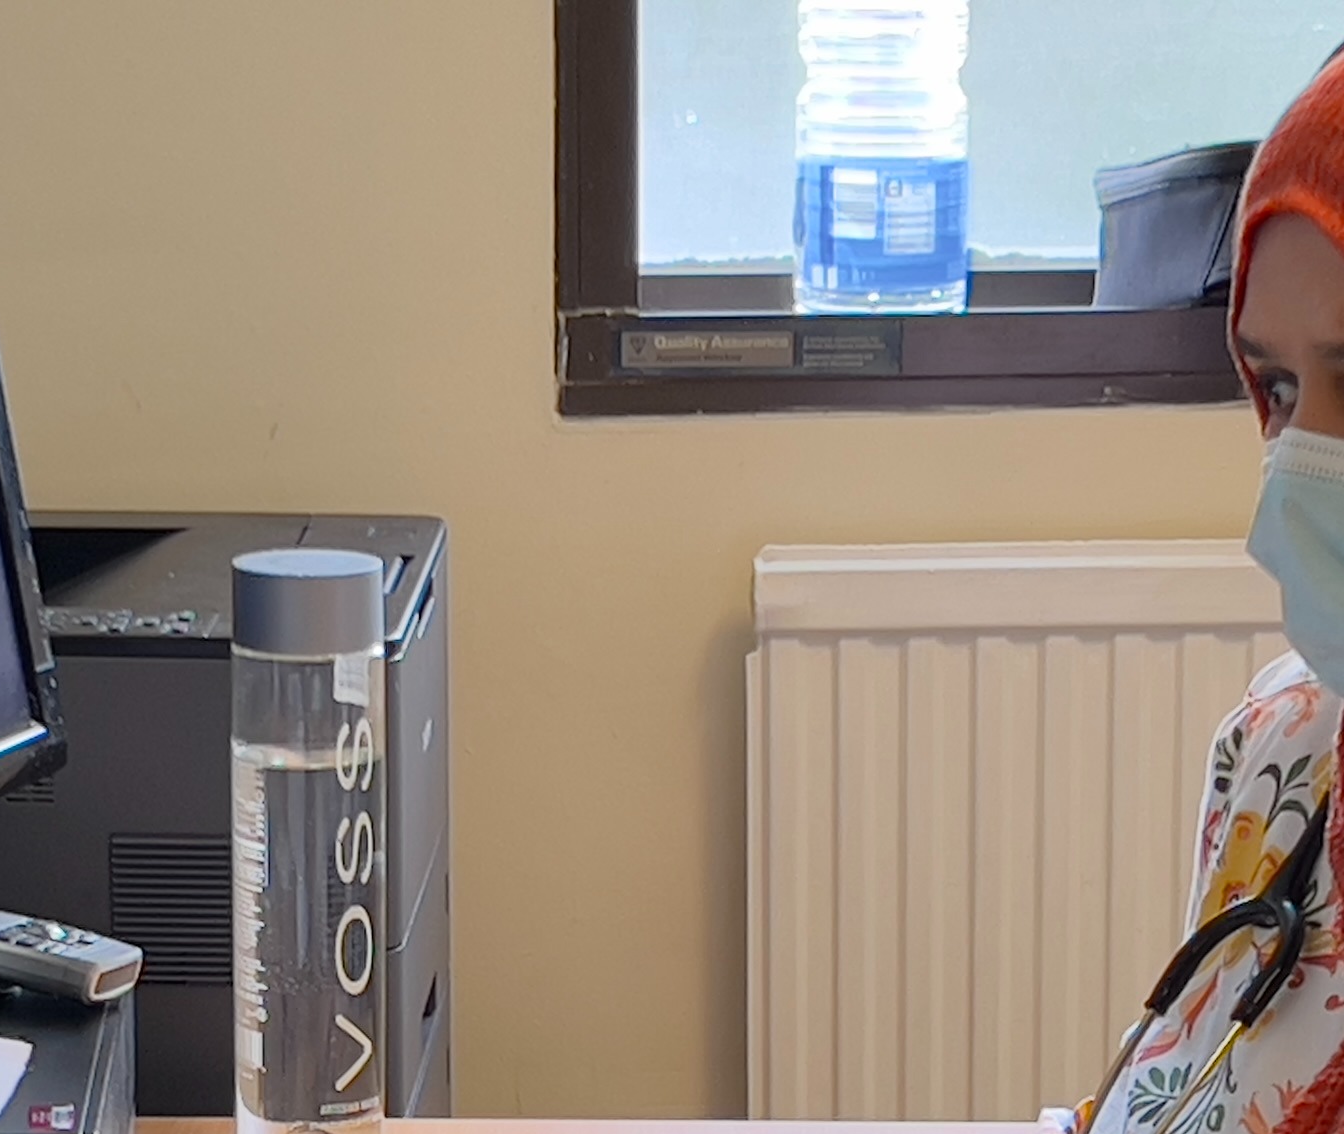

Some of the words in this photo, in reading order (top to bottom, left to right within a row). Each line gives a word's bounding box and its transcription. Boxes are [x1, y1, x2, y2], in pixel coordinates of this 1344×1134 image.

[654, 334, 707, 350] Quality
[711, 334, 790, 349] Assurance
[334, 716, 375, 1093] VOSS
